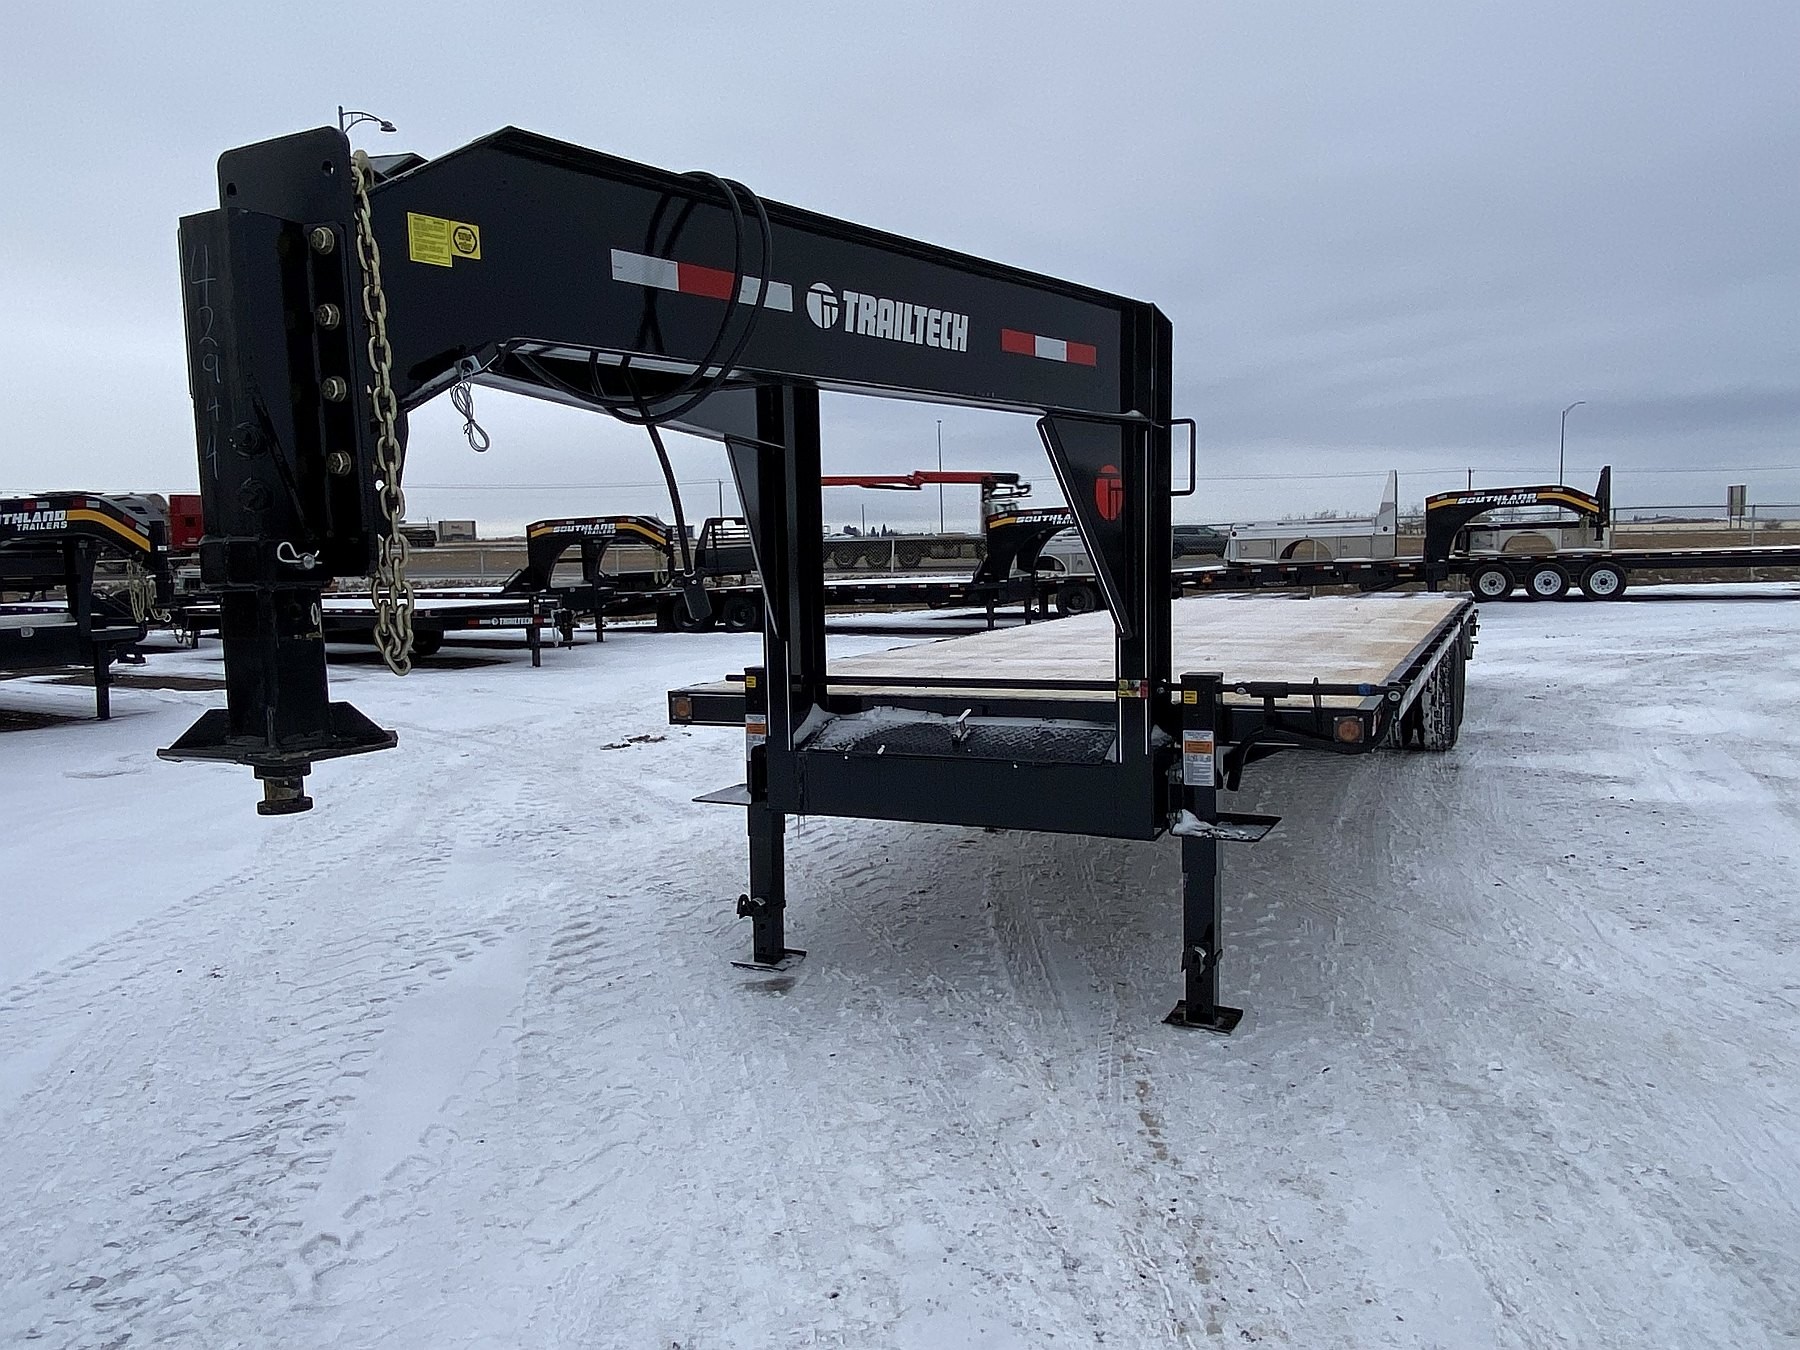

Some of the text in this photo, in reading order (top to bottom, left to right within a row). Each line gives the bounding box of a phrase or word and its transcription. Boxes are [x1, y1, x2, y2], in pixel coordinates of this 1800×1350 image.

[842, 290, 969, 353] TRAILTECH
[1457, 493, 1537, 504] SOUTHLAND
[0, 510, 66, 525] THLAND
[1016, 513, 1072, 523] SOUTHLA
[17, 520, 67, 532] TRAILERS
[553, 523, 616, 533] SOUTHLAND
